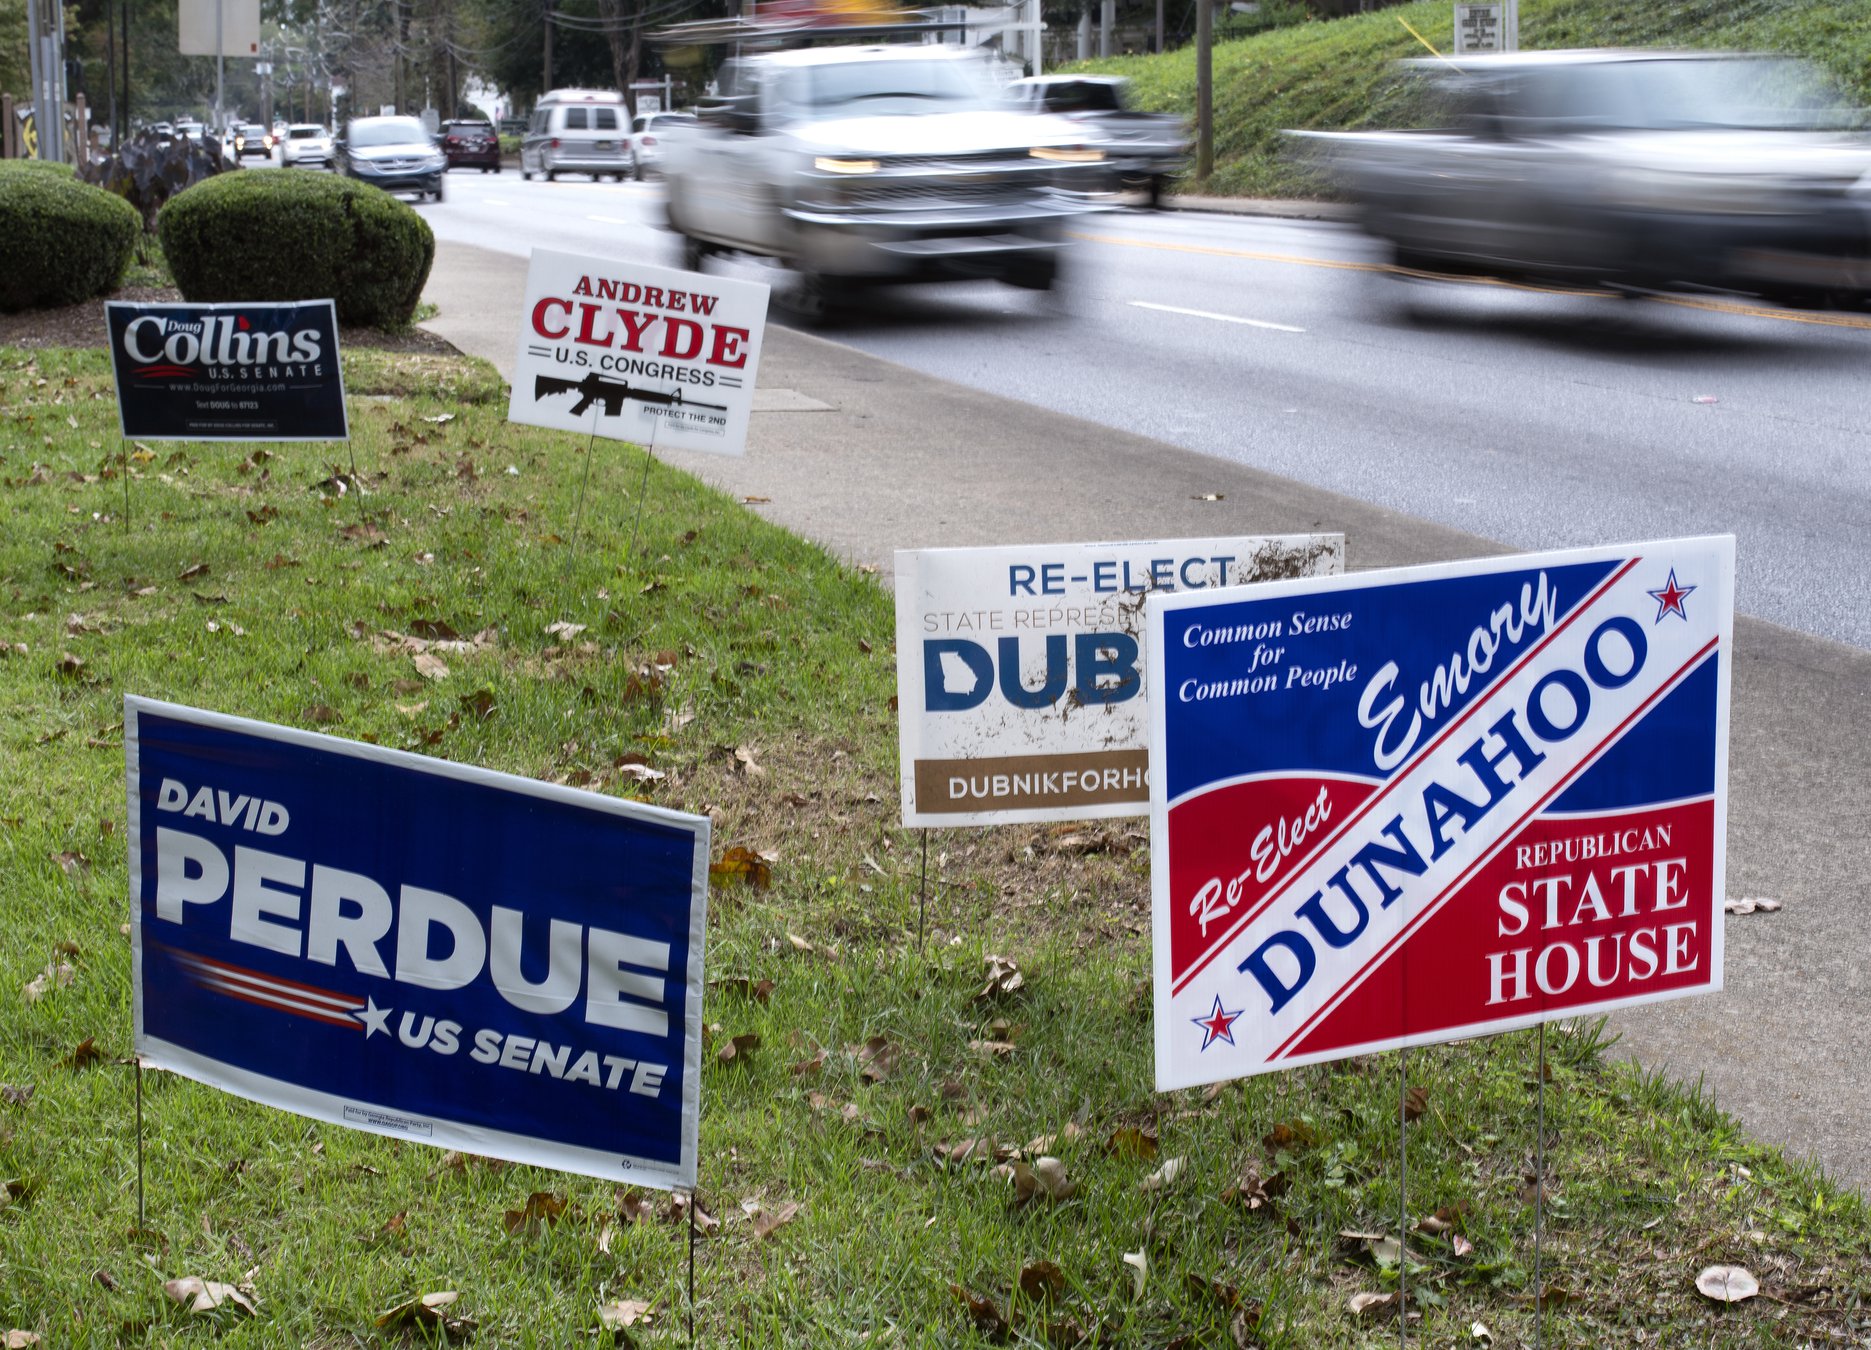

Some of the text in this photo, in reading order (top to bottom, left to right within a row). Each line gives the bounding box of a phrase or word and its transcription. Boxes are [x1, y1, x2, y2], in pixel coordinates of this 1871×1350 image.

[572, 275, 719, 316] ANDREW
[124, 315, 321, 366] Collins
[167, 320, 202, 334] Doug
[531, 297, 750, 369] CLYDE
[169, 382, 286, 394] www.DougForGeorgia.com
[208, 364, 323, 379] U.S. SENATE
[555, 347, 715, 387] U.S. CONGRESS
[210, 400, 230, 410] DOUG
[643, 405, 727, 426] PROTECT THE 2ND
[1009, 556, 1236, 596] RE-ELECT
[923, 609, 1003, 633] STATE
[1182, 610, 1353, 650] Common Sense
[1248, 643, 1285, 674] for
[1357, 569, 1557, 771] Emory
[1179, 659, 1358, 703] Common People
[156, 777, 290, 837] DAVID
[1236, 615, 1648, 1017] DUNAHOO
[1189, 784, 1333, 938] Re-Elect
[1516, 824, 1673, 870] REPUBLICAN
[1498, 857, 1690, 938] STATE
[156, 825, 671, 1038] PERDUE
[1485, 921, 1699, 1007] HOUSE
[398, 1010, 669, 1098] US SENATE
